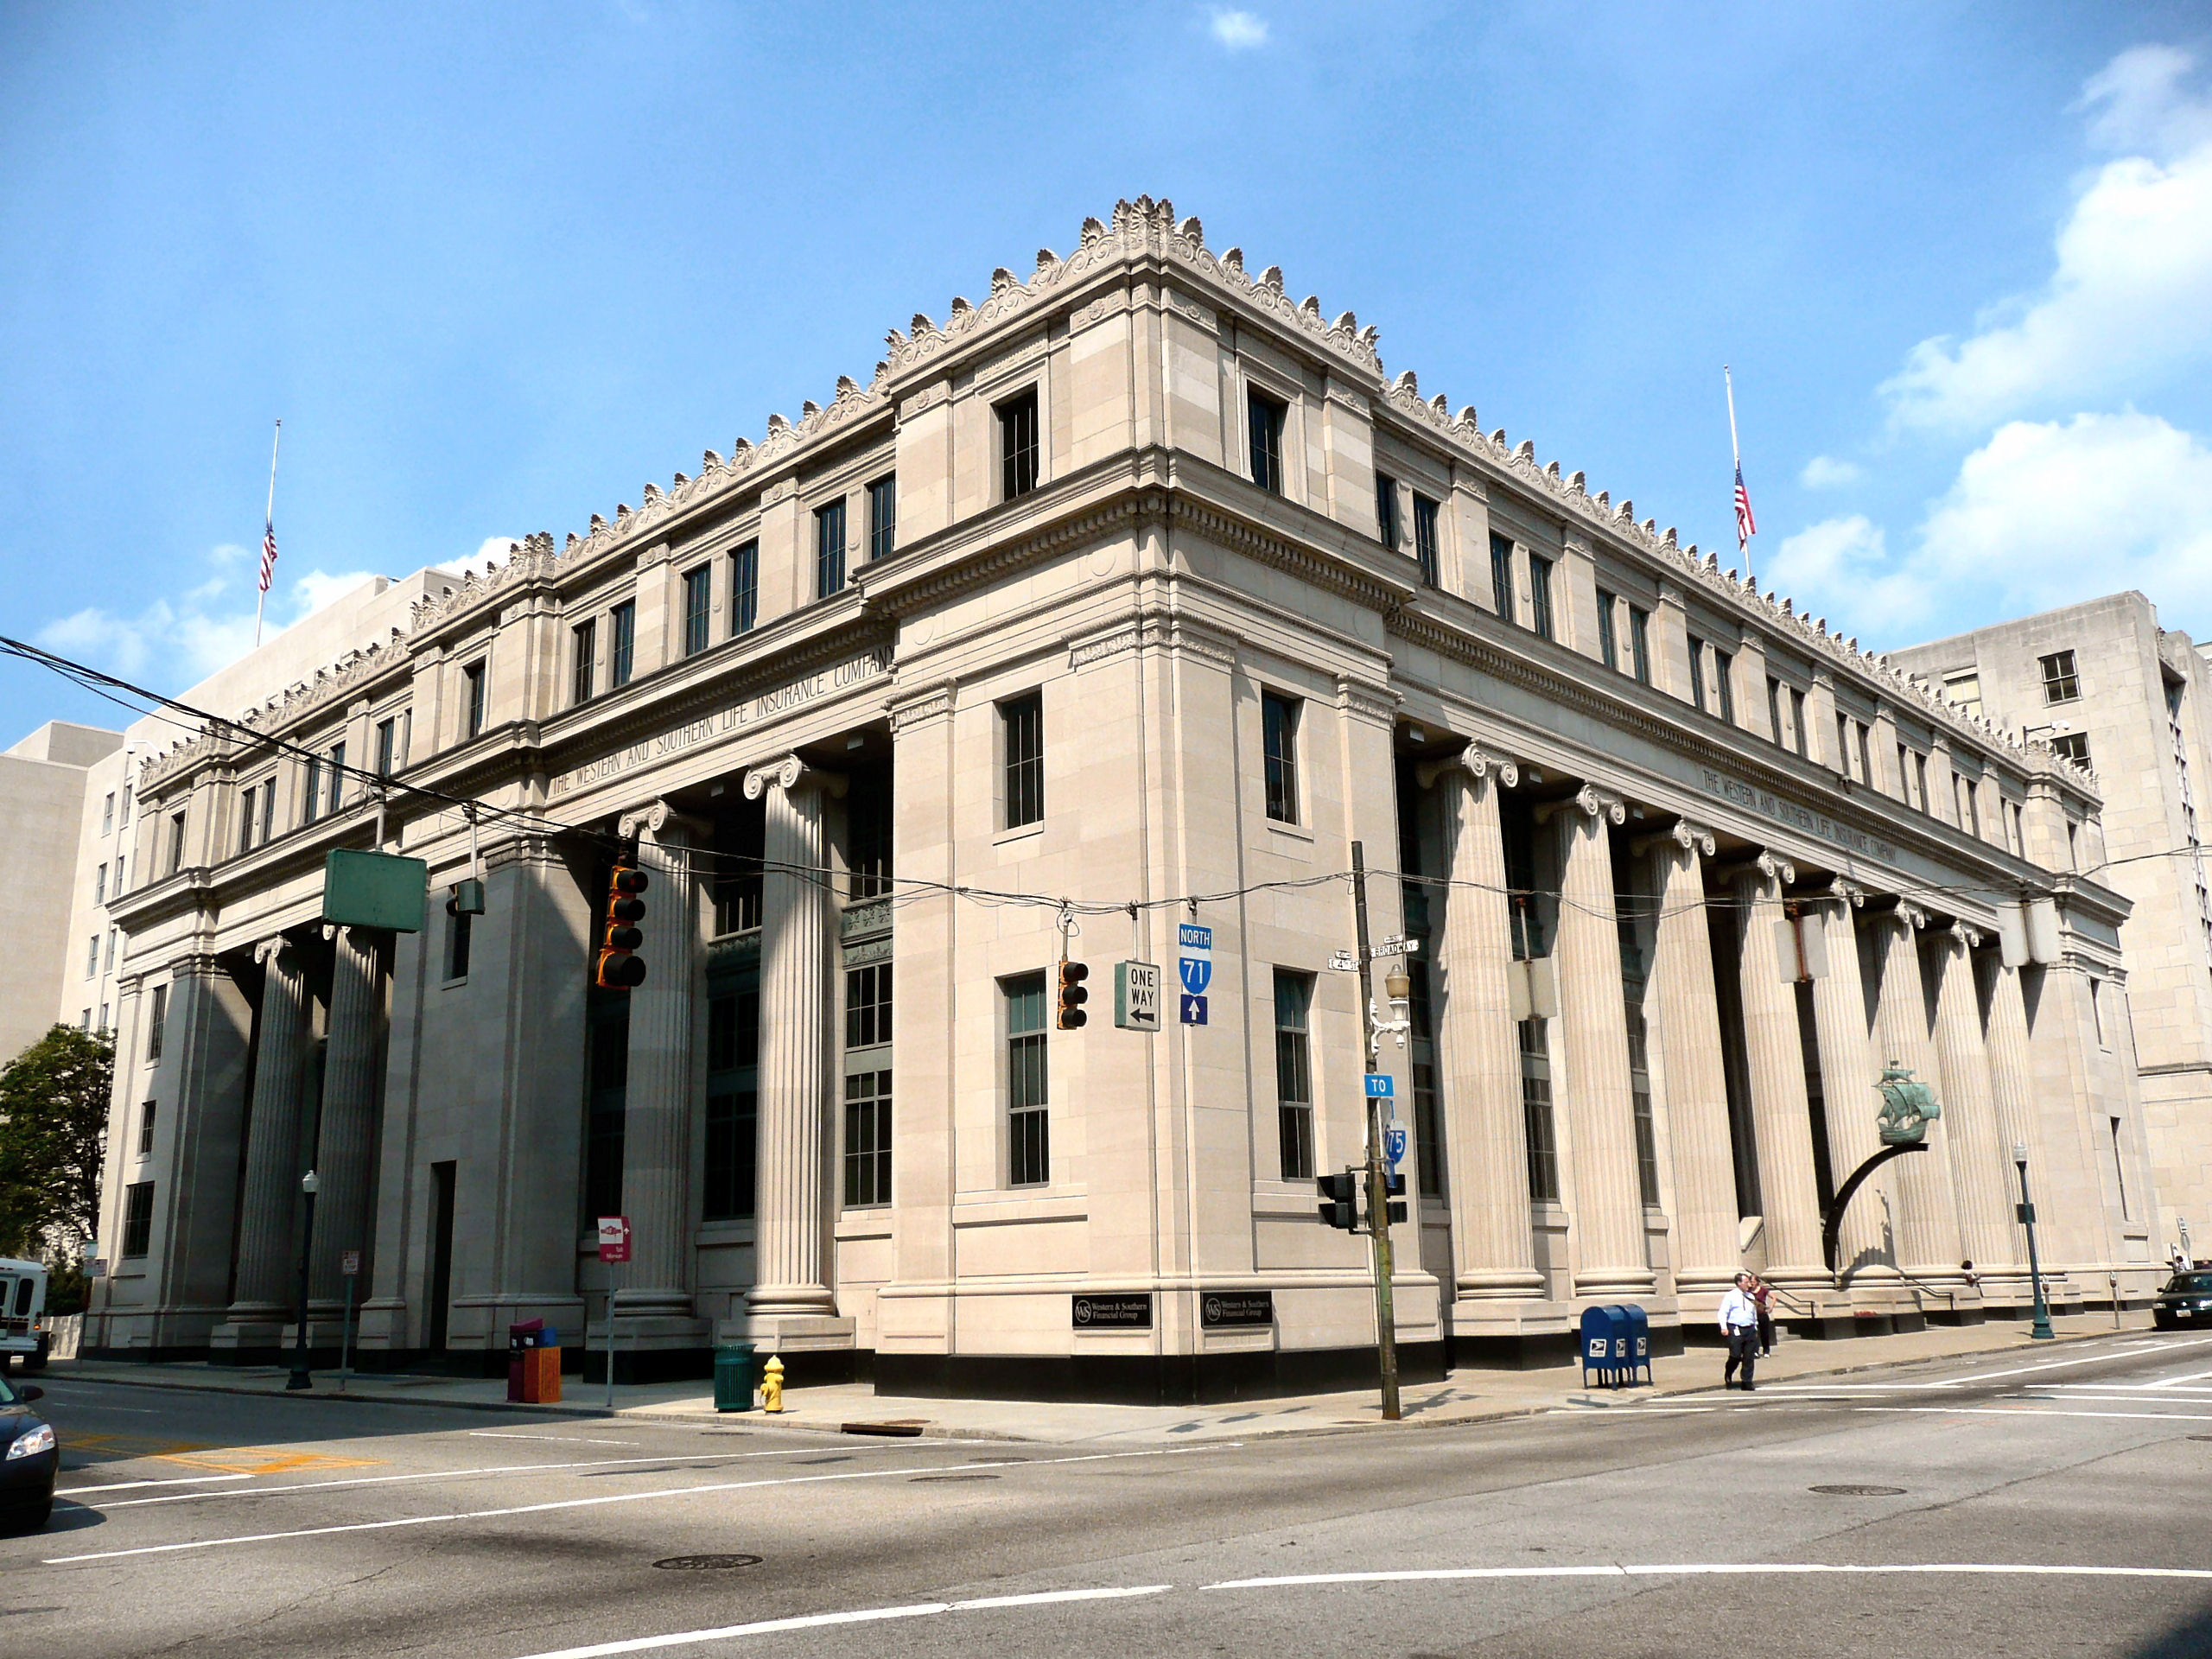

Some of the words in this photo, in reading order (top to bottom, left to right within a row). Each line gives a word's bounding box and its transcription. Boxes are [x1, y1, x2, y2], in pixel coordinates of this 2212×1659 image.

[576, 753, 620, 785] WESTERN
[626, 740, 650, 767] AND
[657, 715, 714, 754] SOUTHERN
[722, 703, 747, 730] LIFE
[757, 670, 825, 718] INSURANCE
[834, 644, 895, 688] COMPANY
[1703, 769, 1720, 794] THE
[1721, 776, 1757, 809] WESTERN
[1759, 792, 1776, 816] AND
[1816, 817, 1833, 838] LIFE
[1180, 928, 1211, 947] NORTH
[1375, 942, 1414, 957] BROADWAY
[1184, 960, 1204, 984] 71
[1350, 961, 1357, 970] ST
[1131, 968, 1154, 988] ONE
[1131, 988, 1154, 1007] WAY
[1371, 1079, 1386, 1093] TO
